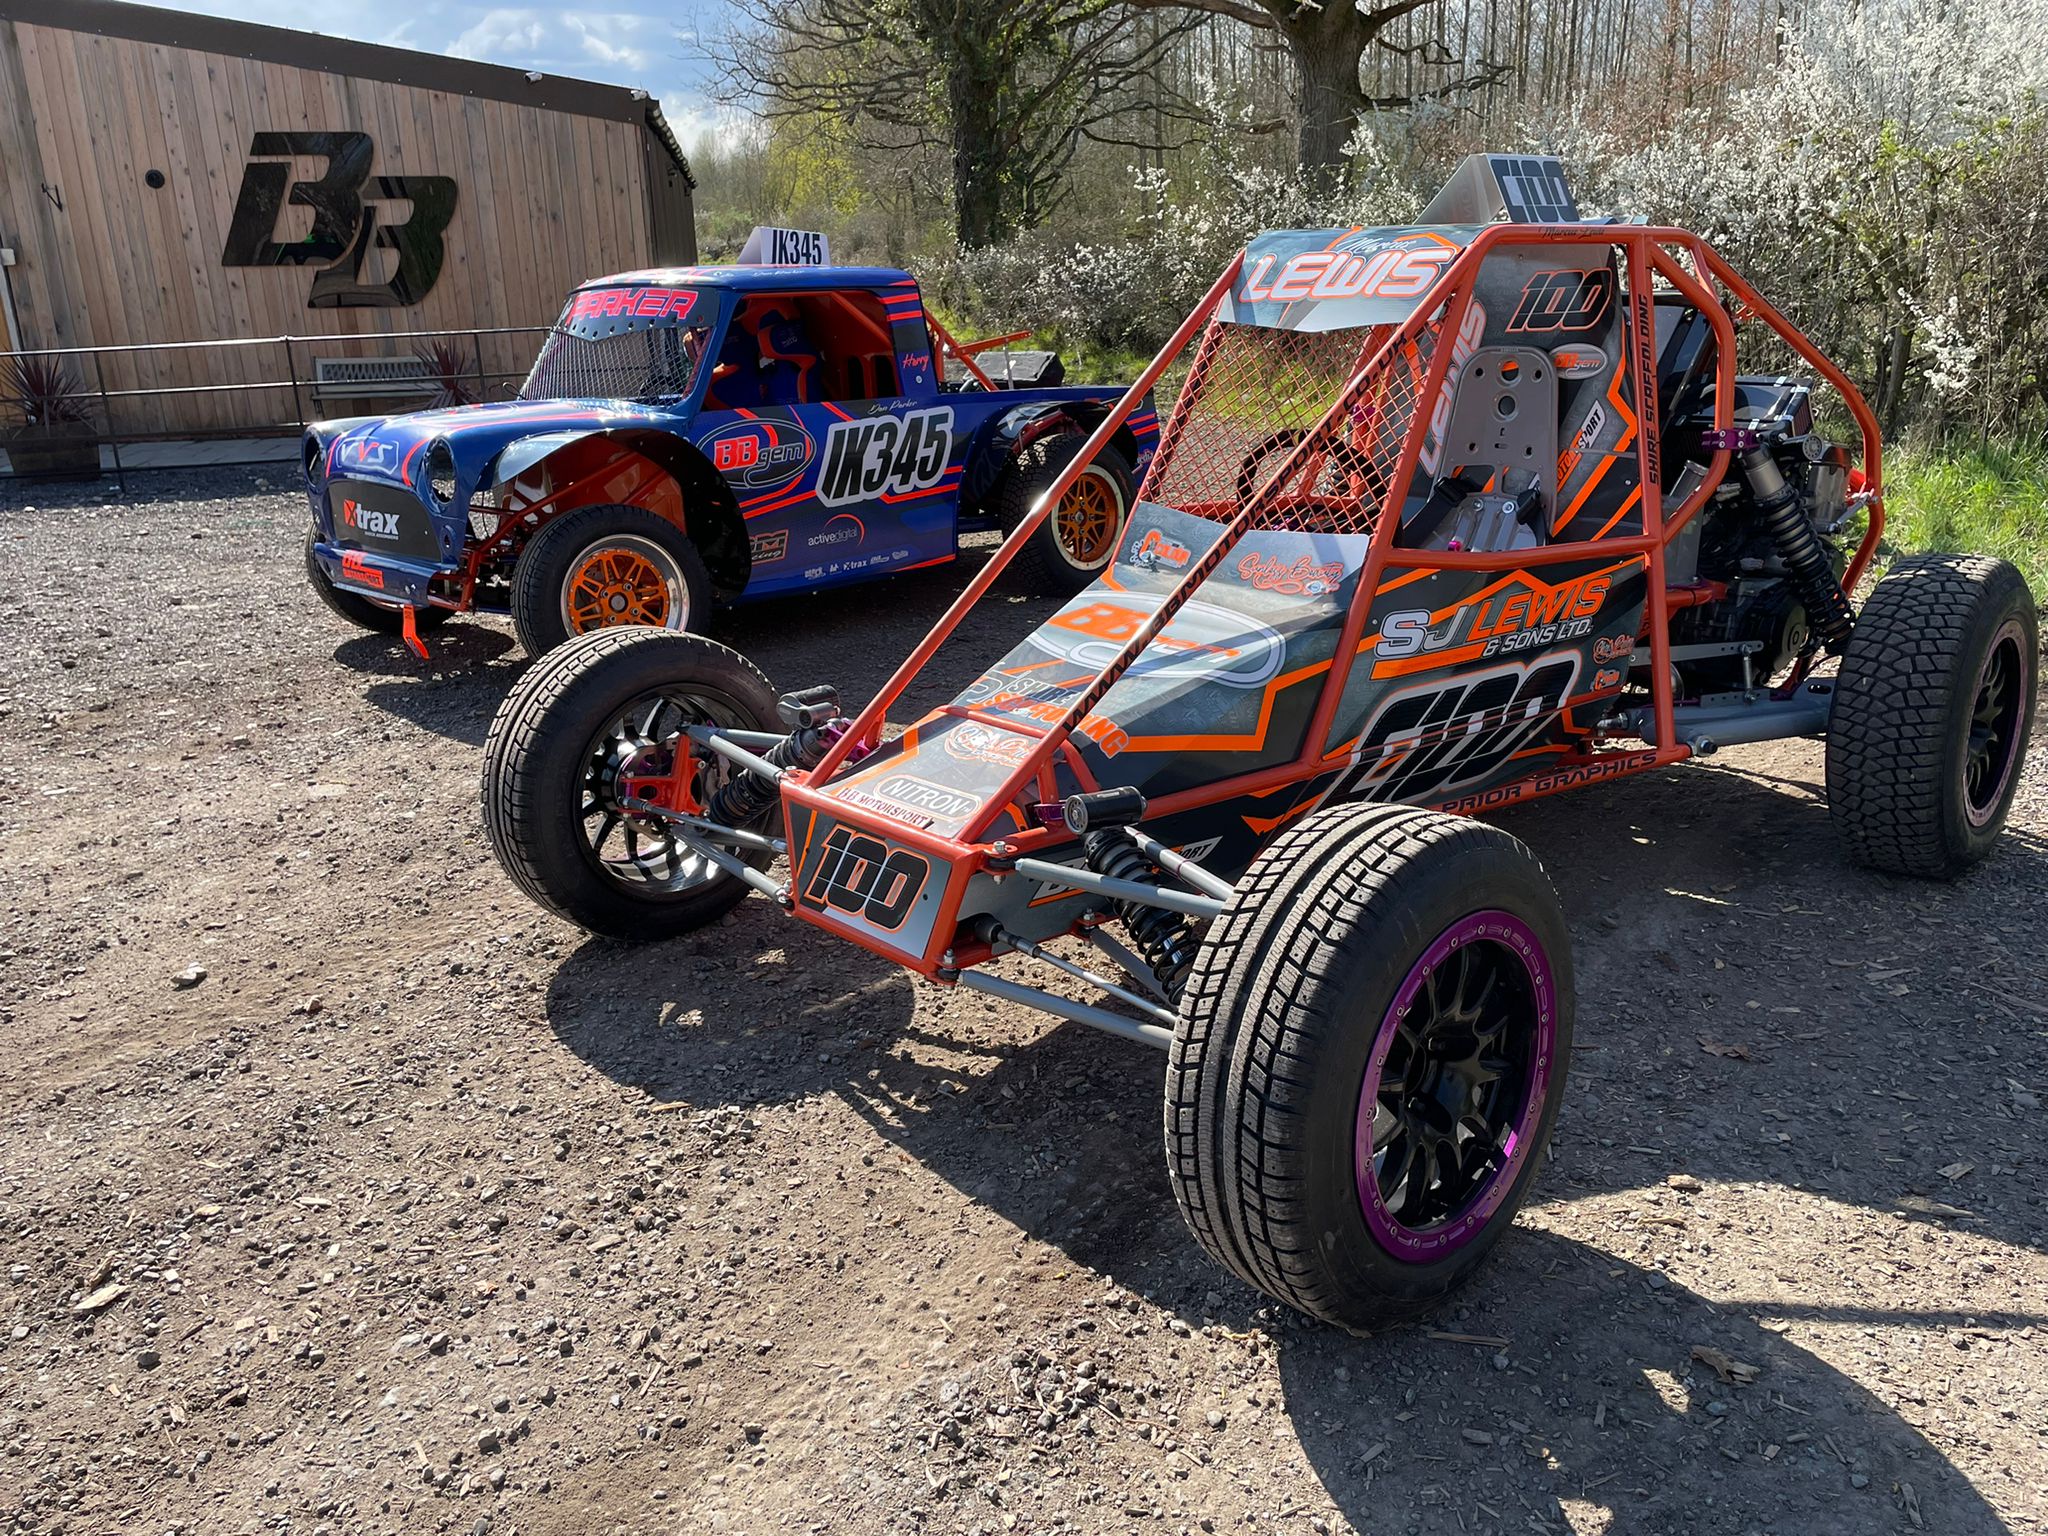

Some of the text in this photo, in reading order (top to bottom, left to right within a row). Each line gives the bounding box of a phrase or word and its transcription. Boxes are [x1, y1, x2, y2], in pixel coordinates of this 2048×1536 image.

[771, 229, 822, 265] IK345
[1240, 246, 1458, 301] LEWIS
[565, 287, 699, 325] PARKER
[1505, 268, 1613, 333] 100
[902, 353, 930, 372] Harry
[888, 399, 918, 412] Parker
[1637, 293, 1660, 486] SHIRE SCAFFOLDING
[818, 409, 952, 504] IK345
[1375, 576, 1613, 658] SJ LEWIS
[1482, 617, 1593, 658] & SONS LTD.
[883, 779, 967, 816] NITRON
[1441, 751, 1658, 814] PRIOR GRAPHICS
[858, 795, 930, 828] MOTORSPORT
[804, 823, 931, 934] 100
